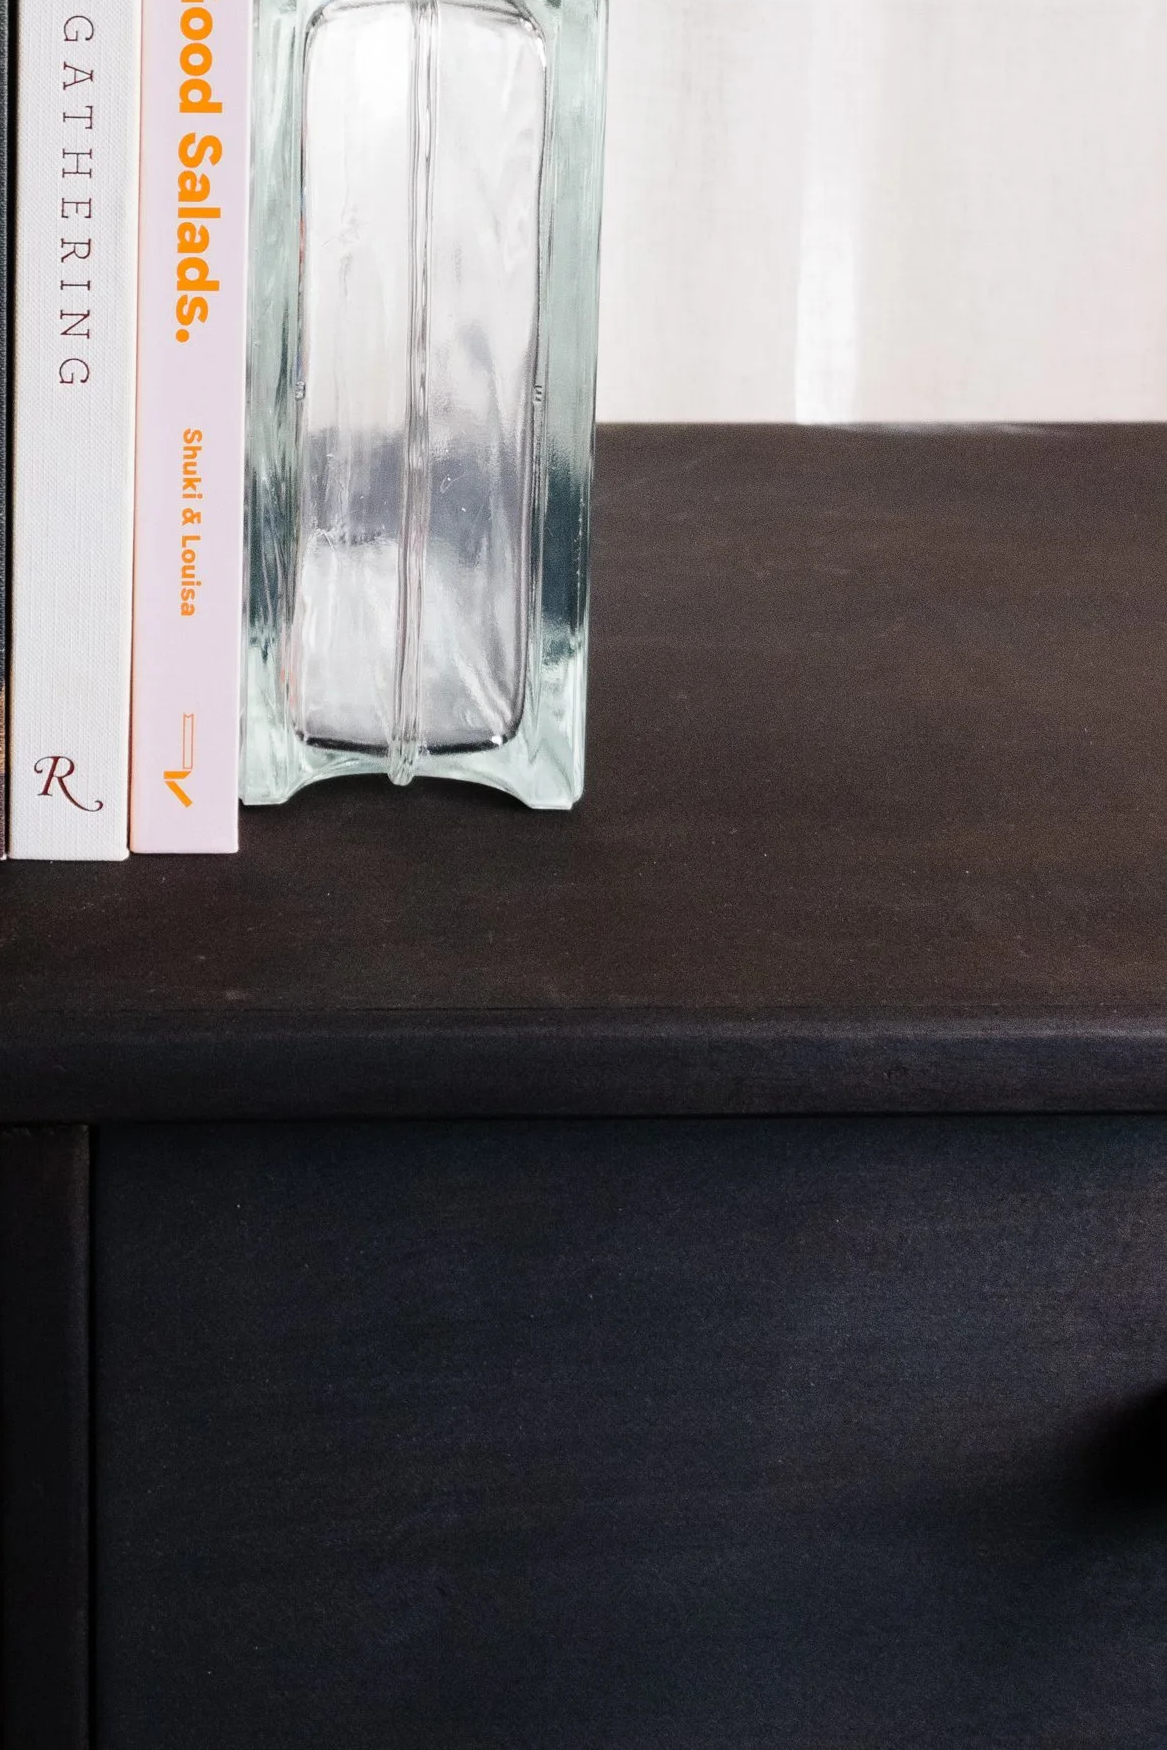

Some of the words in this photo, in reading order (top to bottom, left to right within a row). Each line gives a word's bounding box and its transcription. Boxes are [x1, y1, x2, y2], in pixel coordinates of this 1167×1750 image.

[58, 15, 95, 385] GATHERING
[174, 132, 224, 344] Salads.
[182, 428, 203, 500] Shuki
[181, 508, 202, 526] &
[179, 534, 202, 617] Louisa
